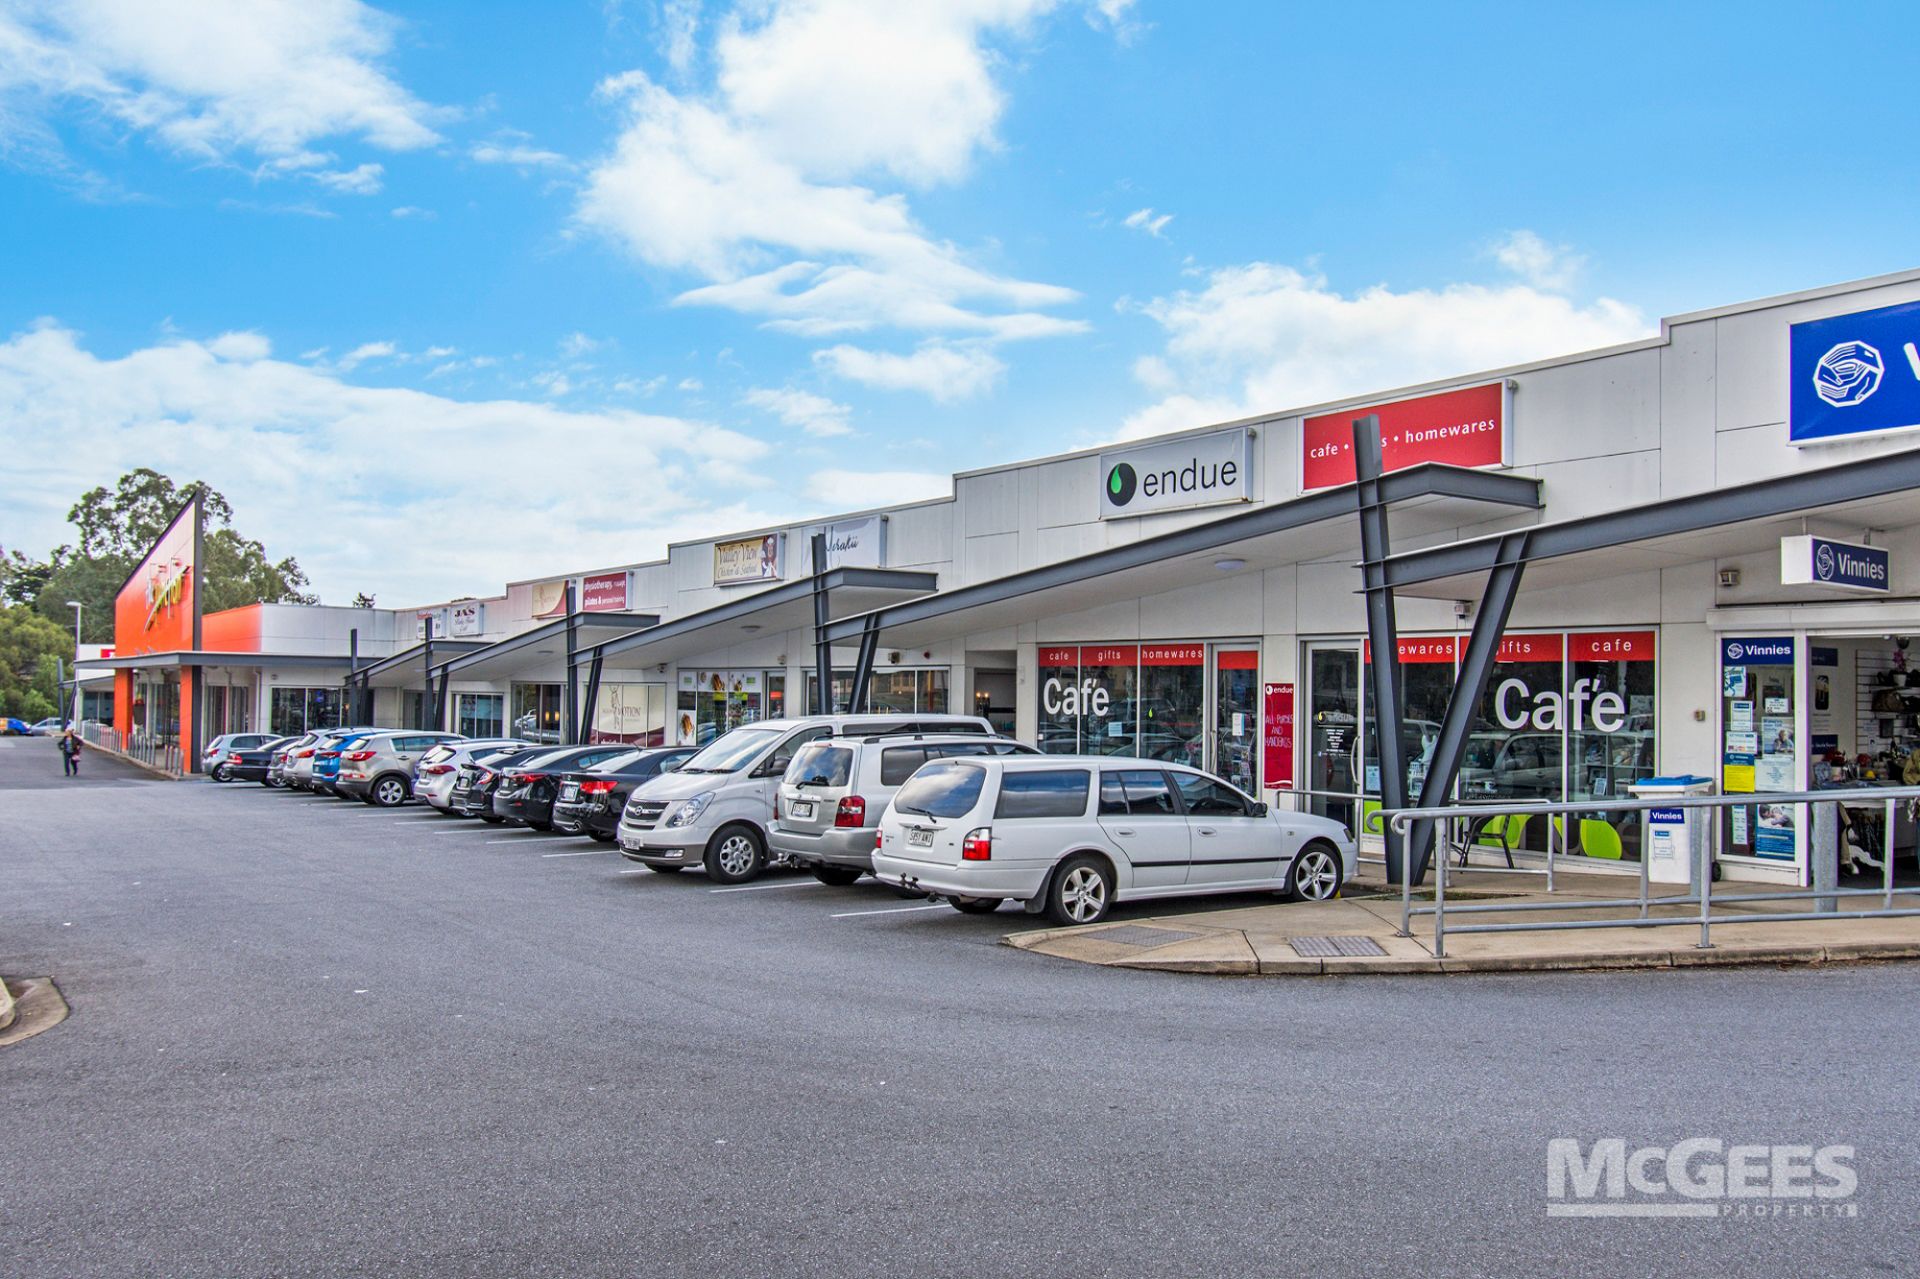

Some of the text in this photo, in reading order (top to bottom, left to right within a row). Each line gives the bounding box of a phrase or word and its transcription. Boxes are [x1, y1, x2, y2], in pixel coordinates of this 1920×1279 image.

[1310, 443, 1338, 458] cafe
[1405, 419, 1495, 443] homewares
[1143, 458, 1237, 497] endue
[1838, 553, 1885, 580] Vinnies
[455, 608, 475, 617] JAS
[1496, 641, 1531, 655] ifts
[1591, 639, 1632, 652] cafe
[1745, 644, 1791, 656] Vinnies
[1049, 649, 1203, 661] cafe gifts homewares
[1274, 686, 1293, 694] endue
[1652, 812, 1682, 820] Vinnies
